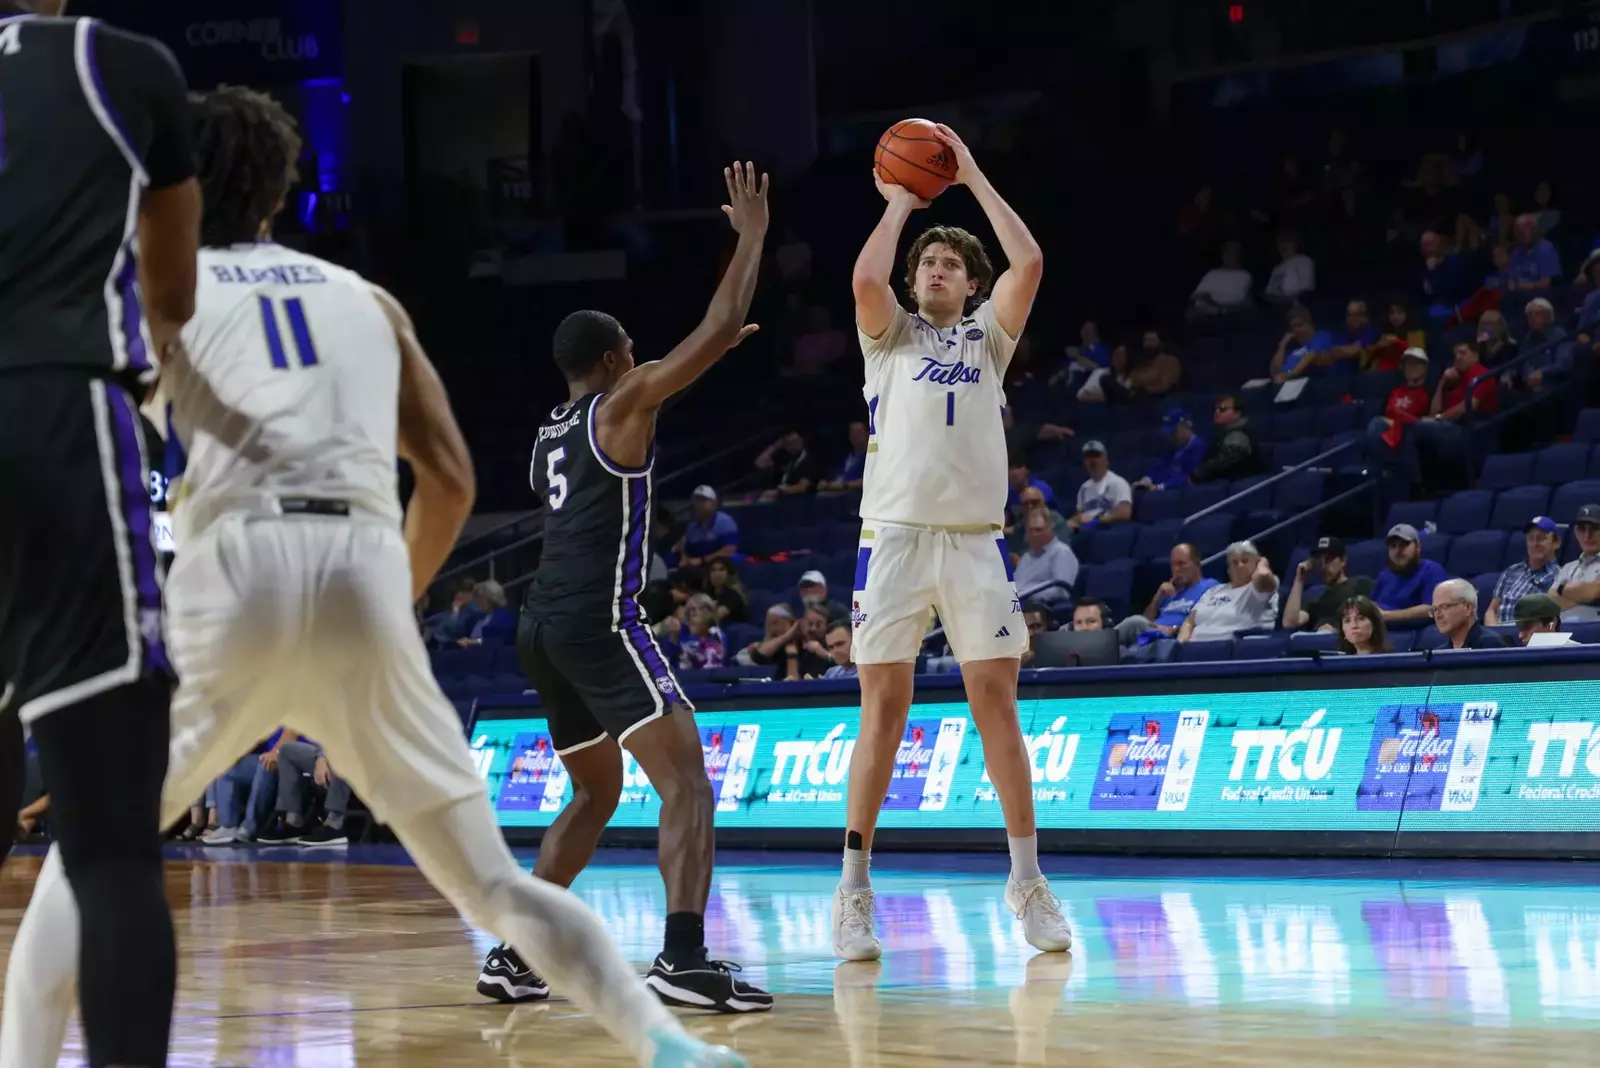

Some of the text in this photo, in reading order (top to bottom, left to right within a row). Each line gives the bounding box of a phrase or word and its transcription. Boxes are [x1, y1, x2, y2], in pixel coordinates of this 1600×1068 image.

[261, 34, 319, 61] CLUB
[257, 294, 319, 369] 11
[912, 357, 981, 385] Tulsa
[946, 391, 955, 426] 1
[546, 446, 568, 511] 5
[1127, 734, 1171, 760] Tulsa
[1229, 708, 1342, 781] TTCU
